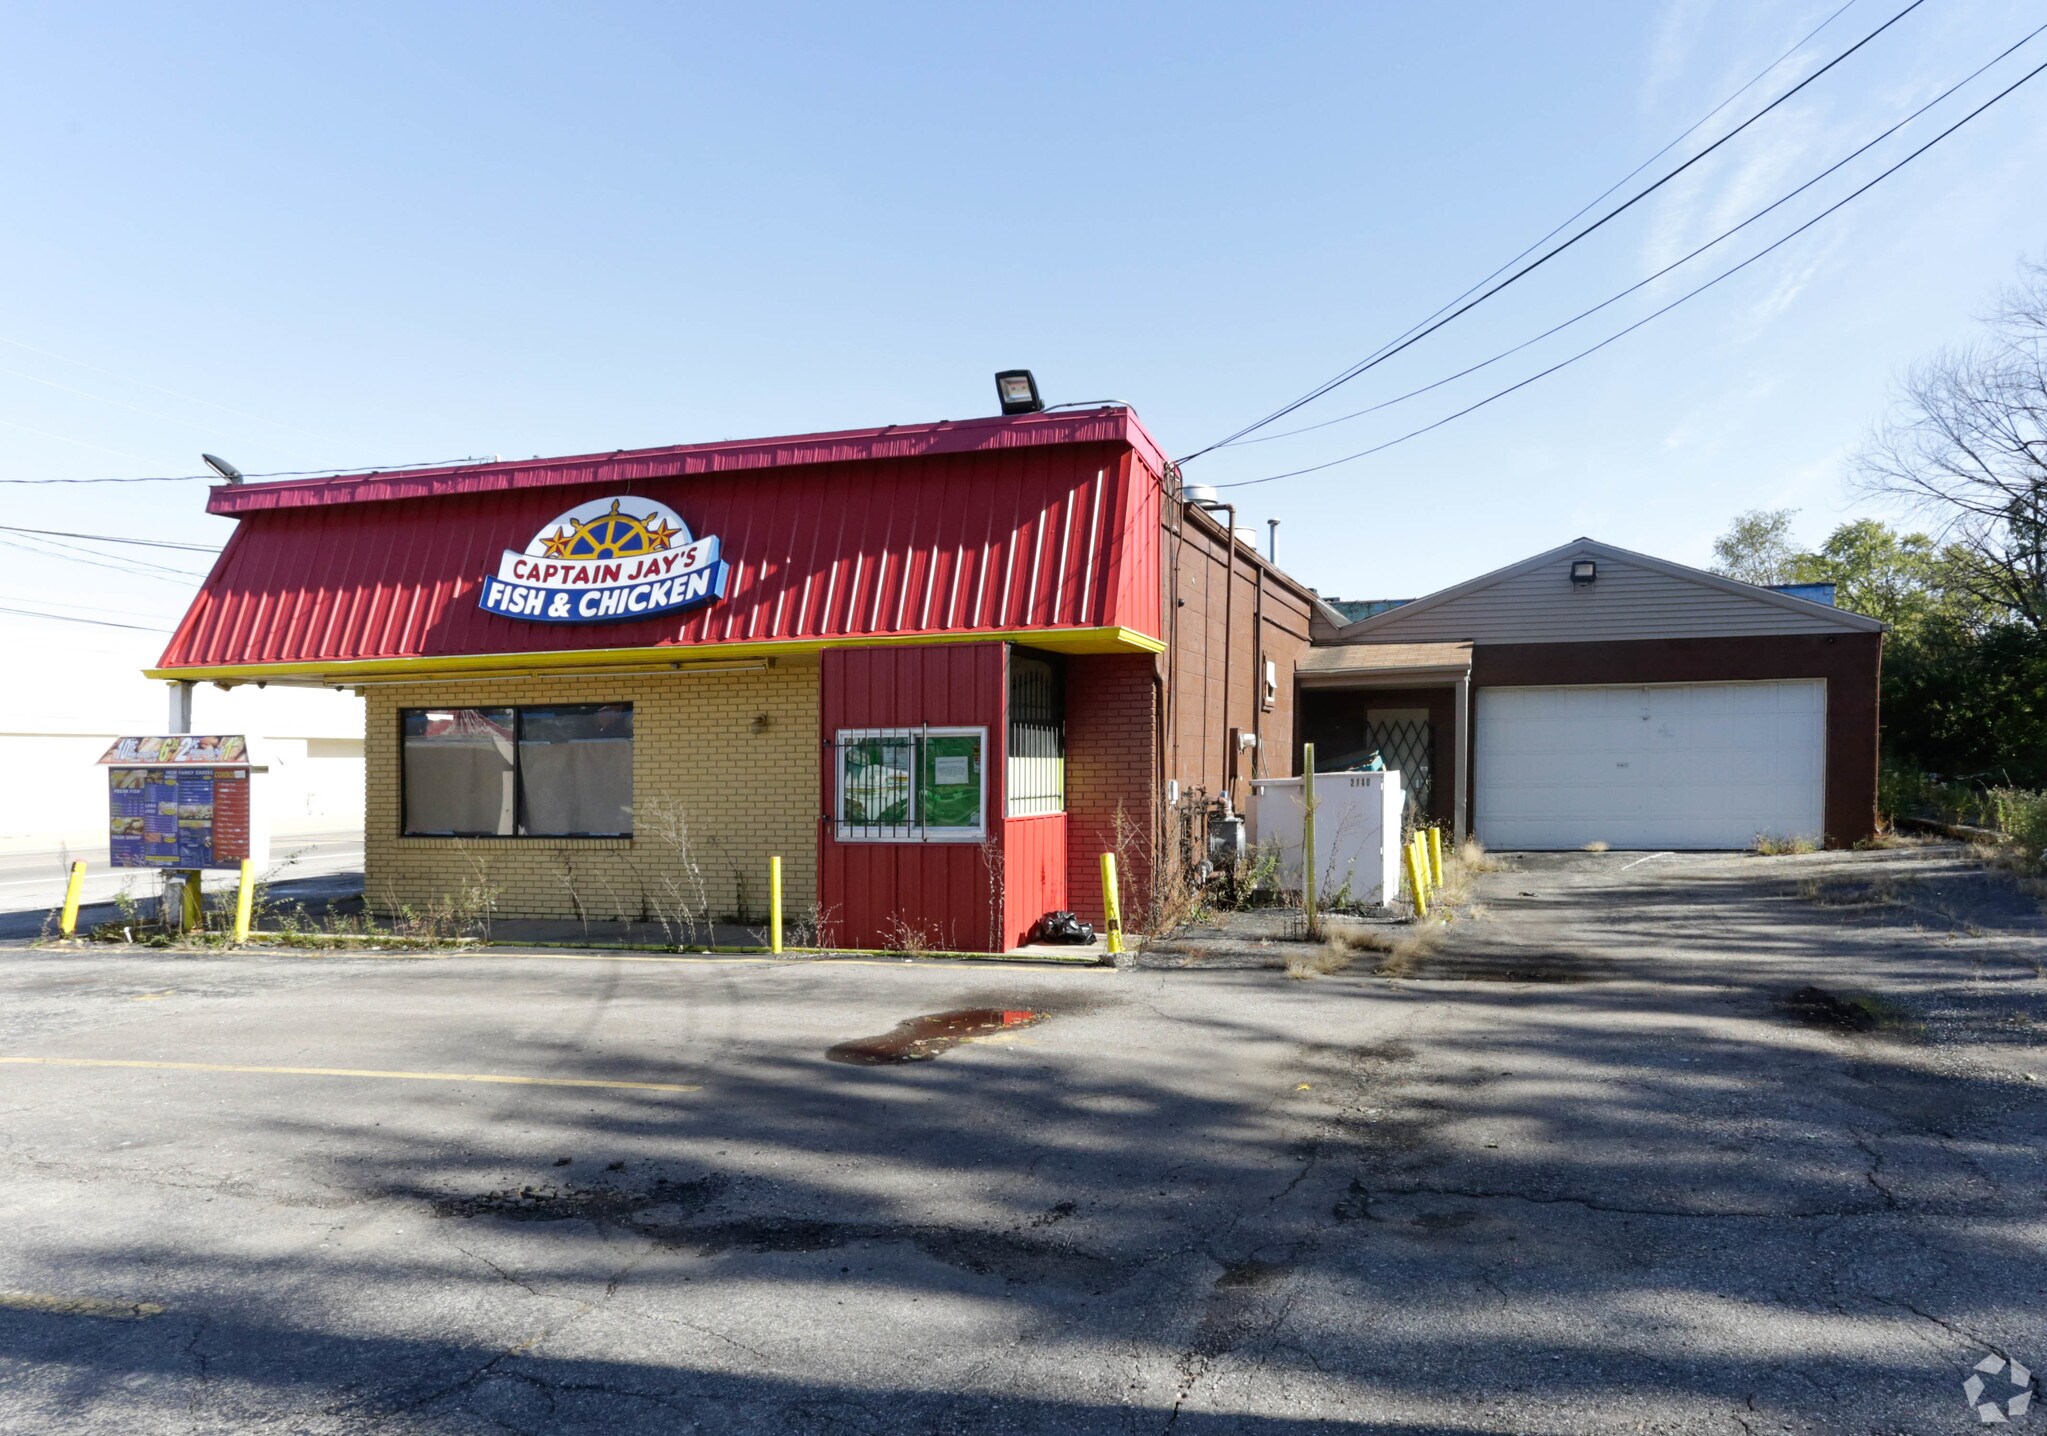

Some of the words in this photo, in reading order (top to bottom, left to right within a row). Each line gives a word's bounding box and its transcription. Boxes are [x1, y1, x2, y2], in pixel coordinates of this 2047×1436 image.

[513, 559, 622, 585] CAPTAIN
[627, 546, 698, 581] JAY'S
[486, 581, 546, 616] FISH
[547, 592, 571, 618] &
[578, 568, 711, 617] CHICKEN
[175, 737, 193, 762] 2
